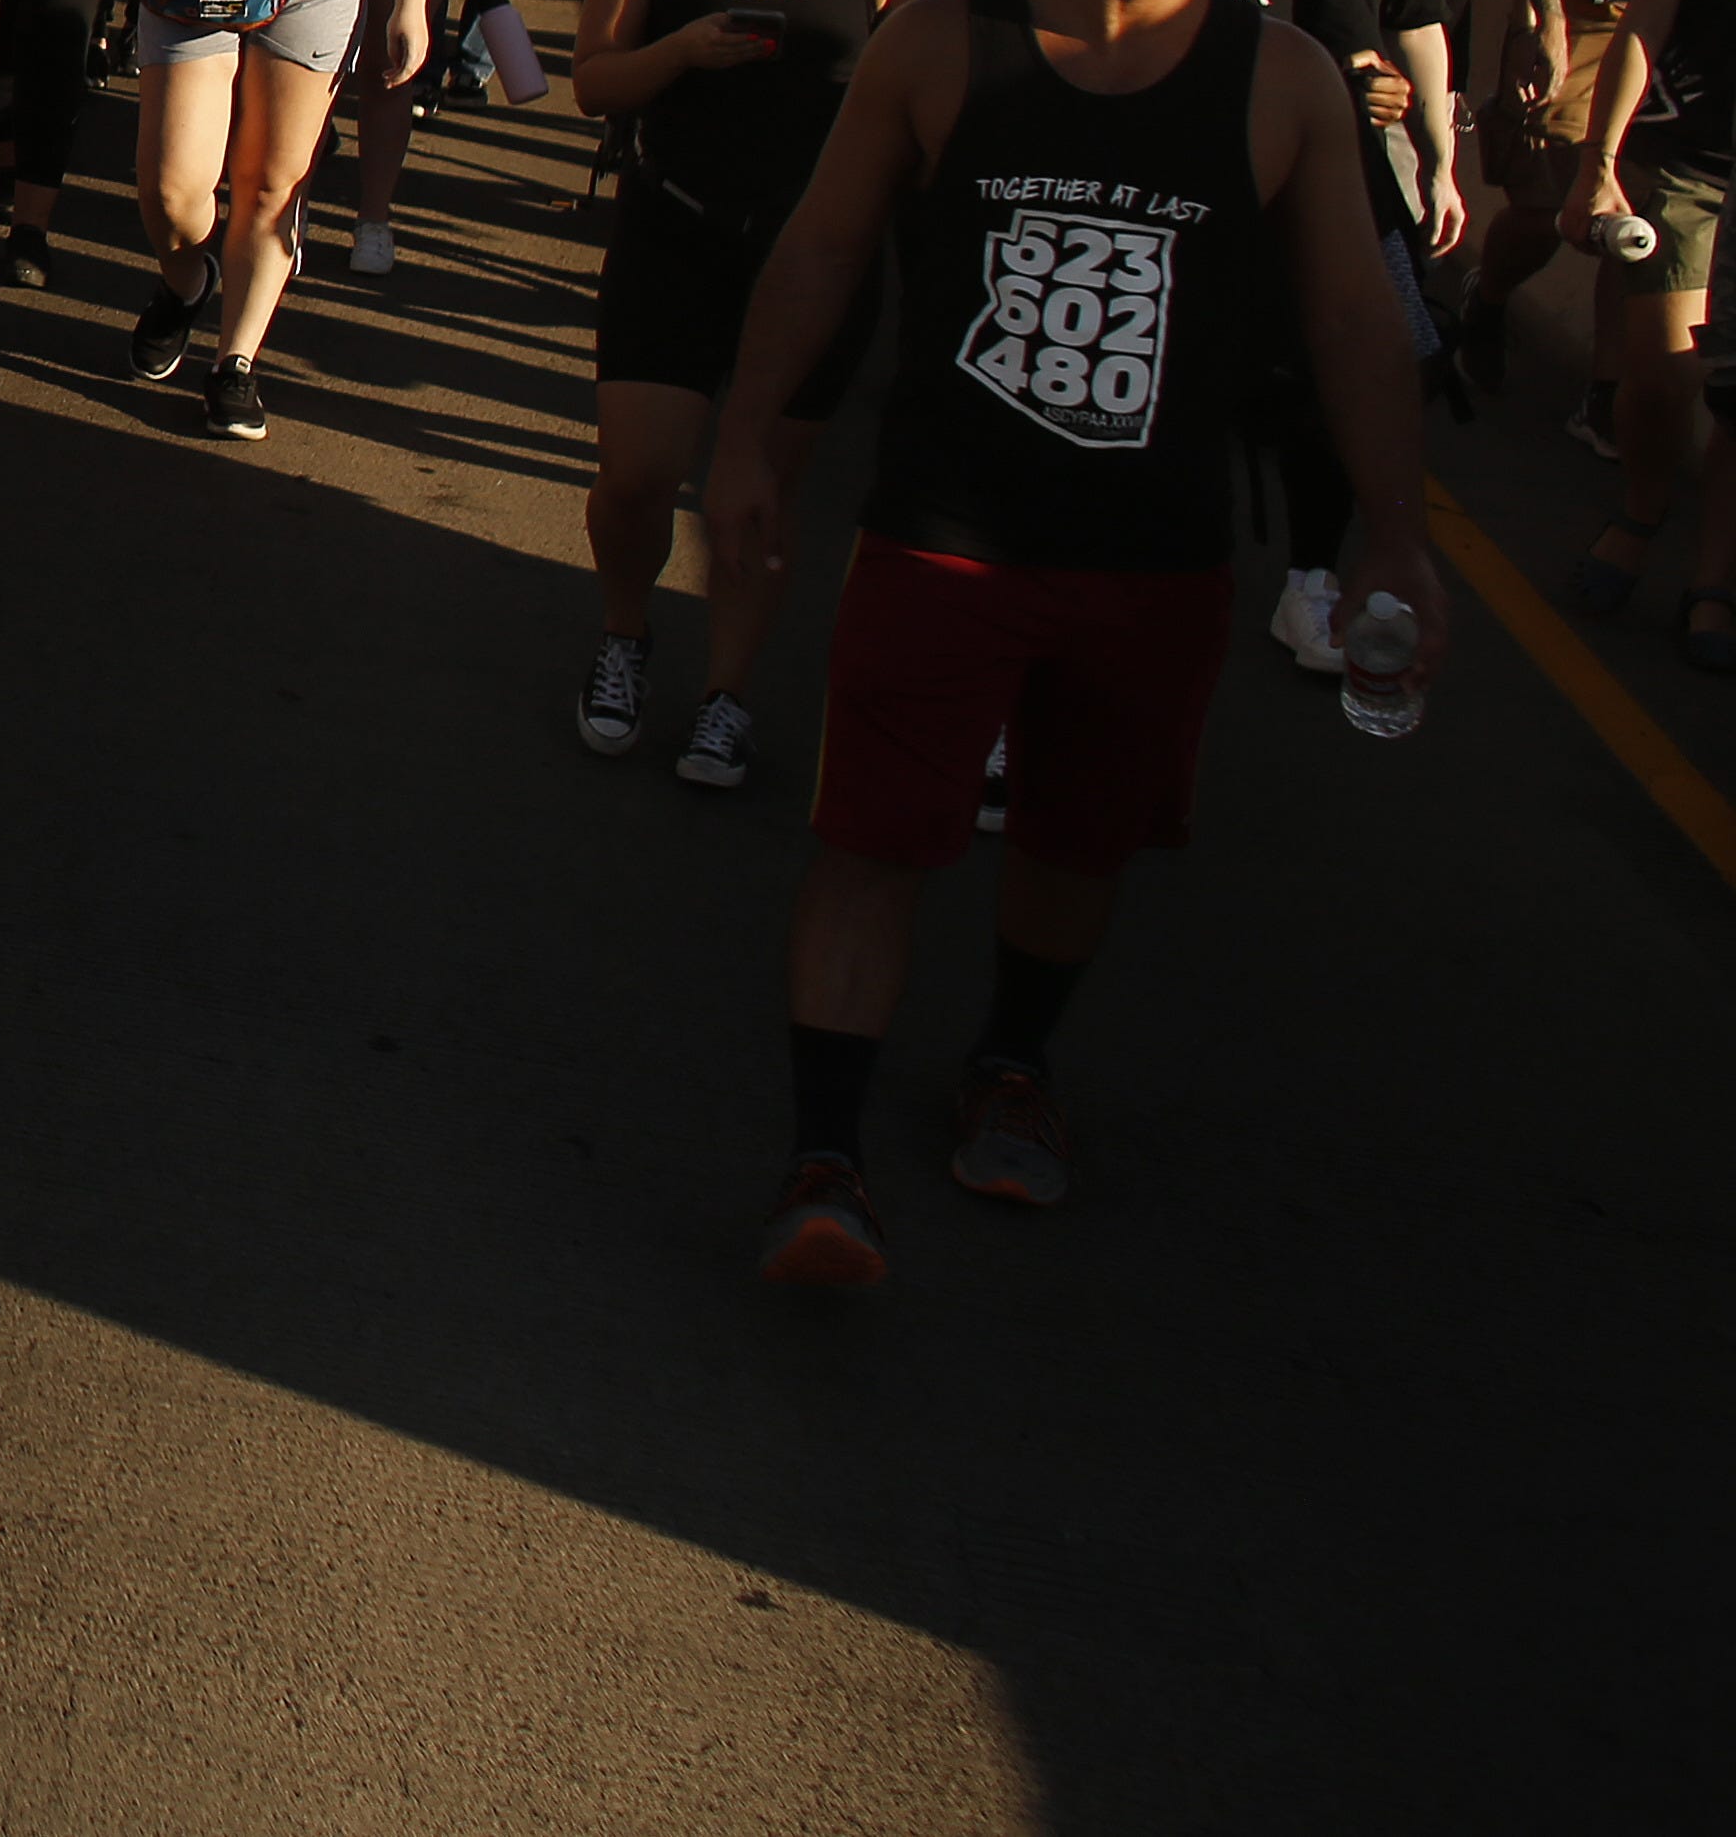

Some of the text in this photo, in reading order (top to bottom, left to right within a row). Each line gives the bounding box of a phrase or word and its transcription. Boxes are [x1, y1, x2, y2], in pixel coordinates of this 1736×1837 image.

[977, 177, 1210, 223] TOGETHER AT LAST
[1001, 218, 1163, 294] 623
[992, 273, 1157, 355] 602
[976, 335, 1151, 414] 480
